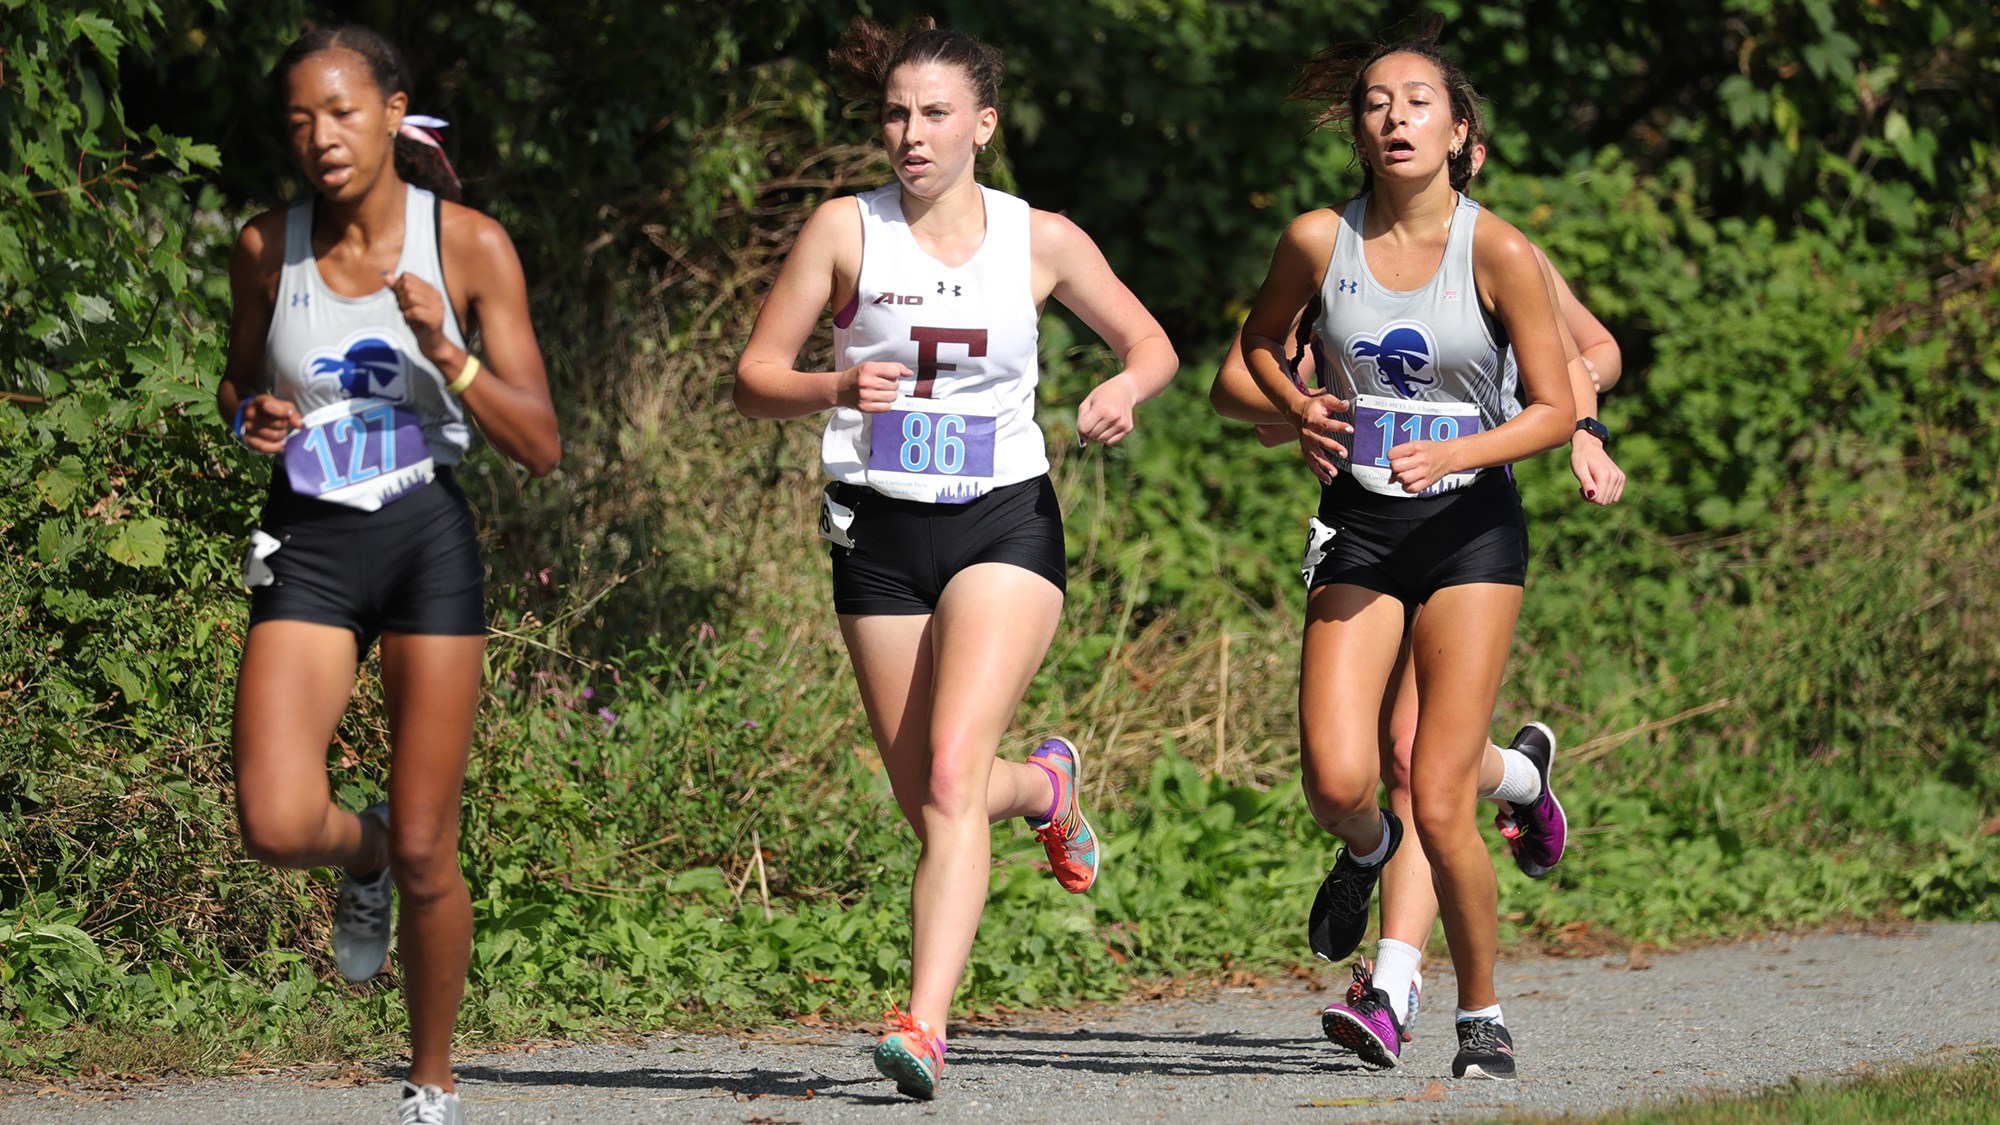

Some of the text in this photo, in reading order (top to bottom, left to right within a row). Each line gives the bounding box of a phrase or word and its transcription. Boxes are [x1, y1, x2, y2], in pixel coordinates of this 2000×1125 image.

[905, 326, 988, 400] F
[303, 405, 396, 492] 127
[900, 412, 966, 474] 86
